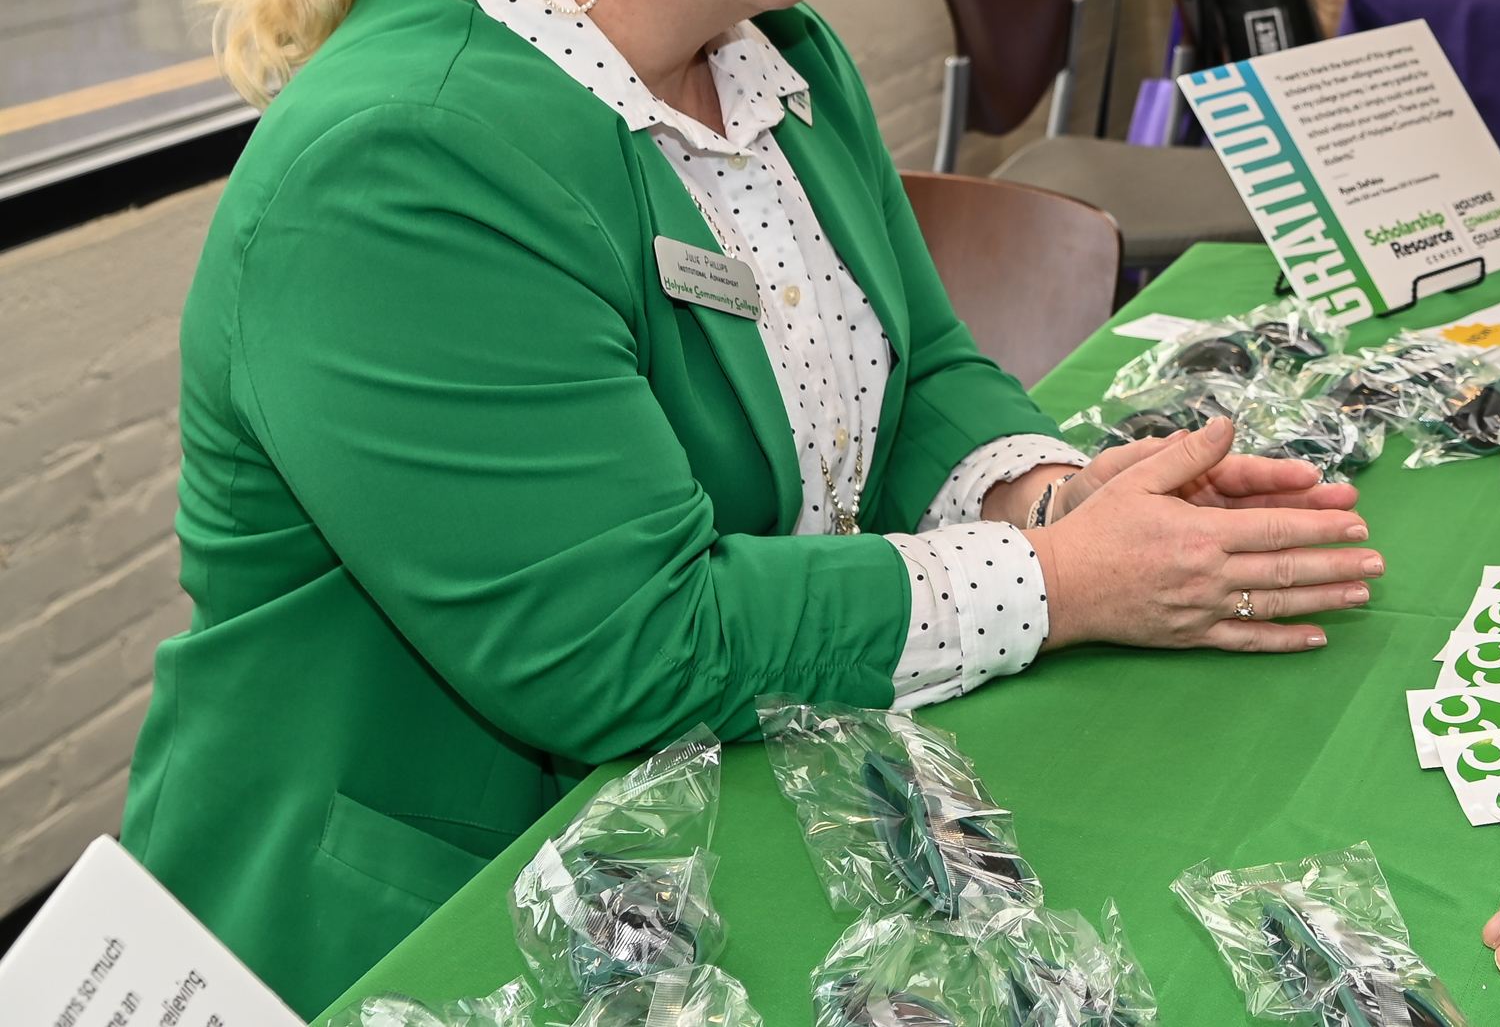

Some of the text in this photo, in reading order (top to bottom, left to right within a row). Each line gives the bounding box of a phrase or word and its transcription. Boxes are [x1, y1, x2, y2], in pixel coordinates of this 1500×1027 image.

[1184, 64, 1374, 328] GRATITUDE
[1453, 190, 1496, 215] HOLYOKE
[1363, 210, 1446, 247] Scholarship
[1390, 229, 1455, 260] Resource
[1425, 245, 1464, 265] CENTER
[663, 276, 759, 316] Holyoke Community College
[77, 979, 97, 1002] so
[91, 936, 126, 983] much
[121, 991, 141, 1015] an
